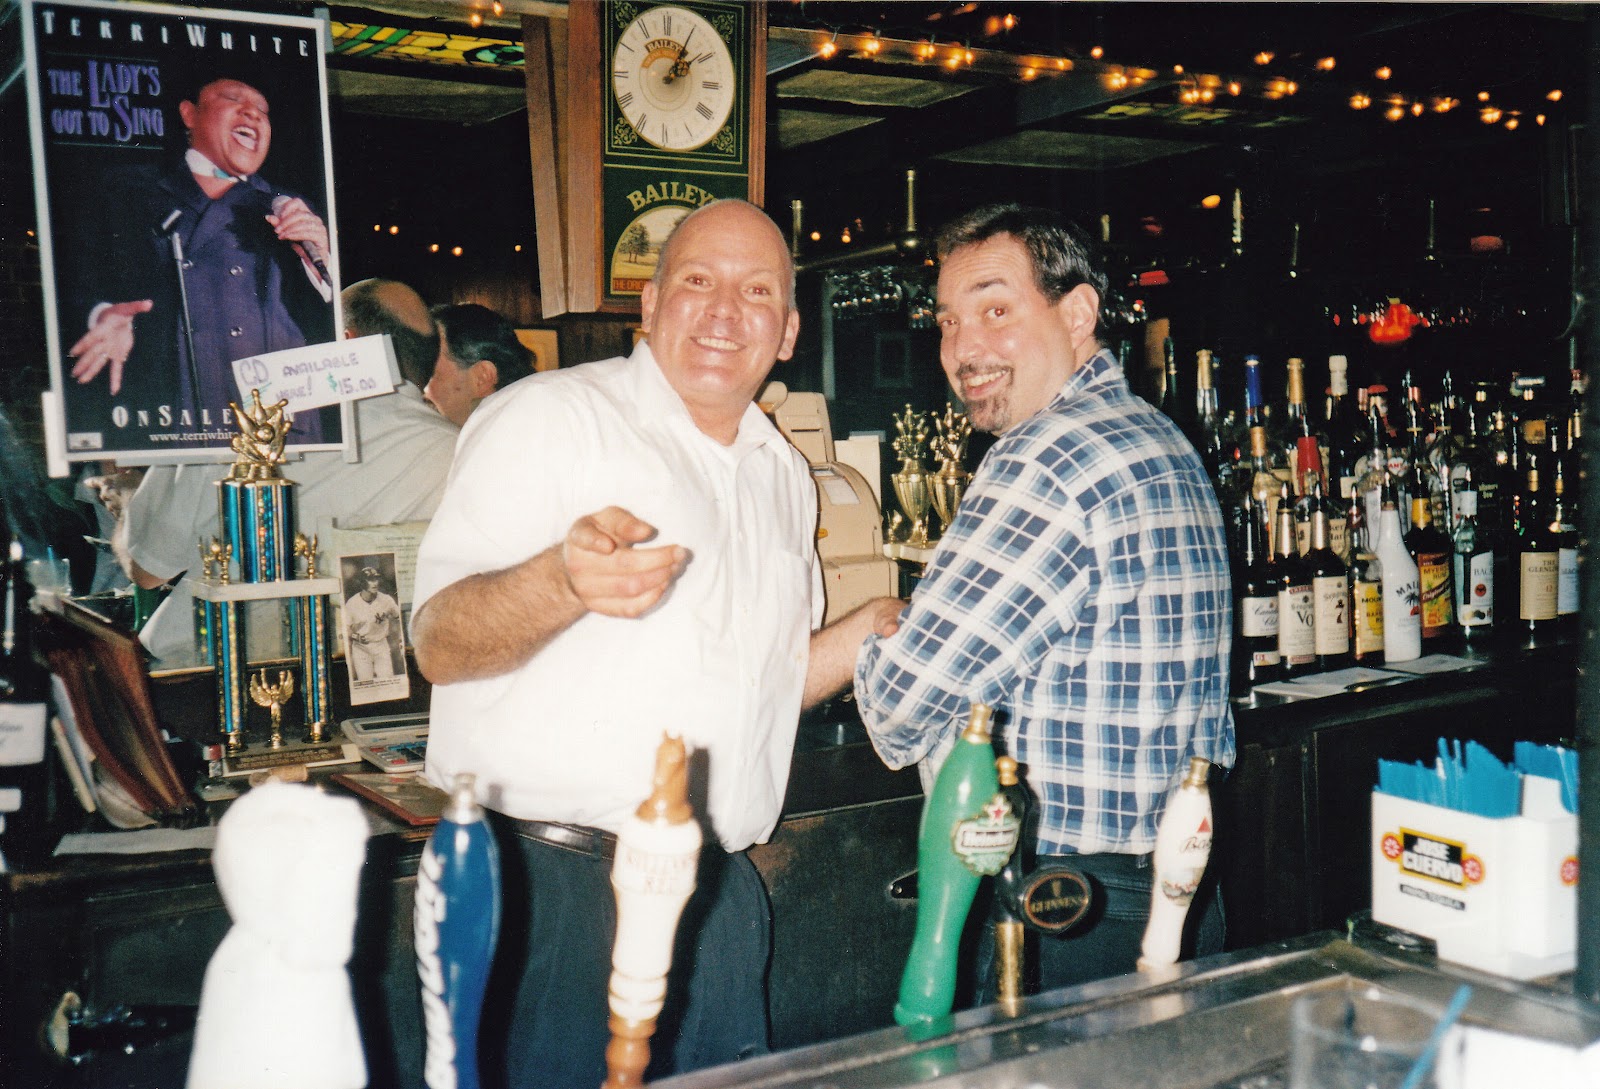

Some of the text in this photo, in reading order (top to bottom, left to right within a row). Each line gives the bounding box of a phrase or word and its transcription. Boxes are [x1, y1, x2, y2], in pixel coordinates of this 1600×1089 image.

[42, 9, 309, 57] TERRI WHITE
[47, 60, 161, 108] THE LADY'S
[51, 94, 164, 141] GOT TO SING
[626, 181, 719, 212] BAILEY
[239, 353, 360, 387] CD AVAILABLE
[1413, 837, 1450, 861] JOSE
[1402, 850, 1464, 885] CUERVO
